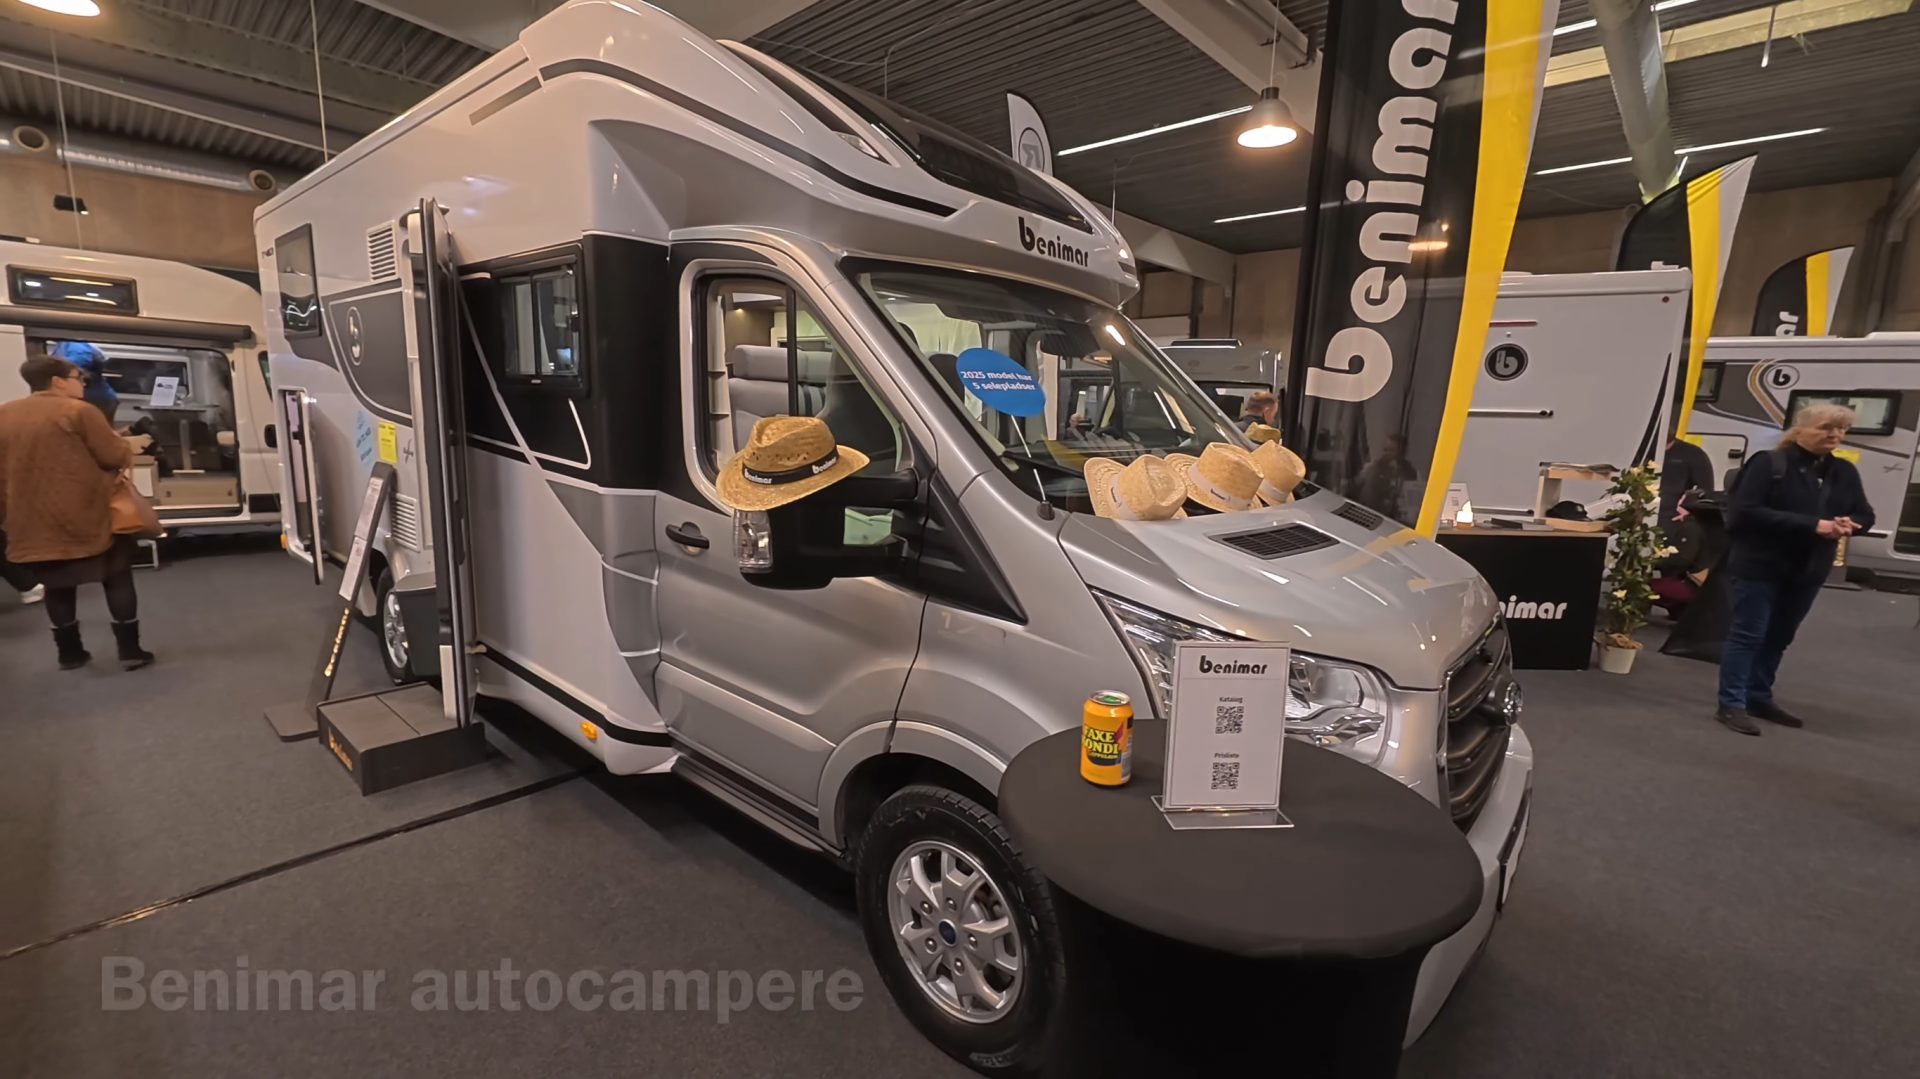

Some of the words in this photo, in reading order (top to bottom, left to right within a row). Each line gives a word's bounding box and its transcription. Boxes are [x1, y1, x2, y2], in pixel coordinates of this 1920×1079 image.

[1305, 0, 1460, 402] benimar
[1018, 216, 1089, 268] benimar
[960, 371, 986, 379] 2025
[987, 372, 1017, 380] model
[1017, 373, 1033, 381] har
[972, 382, 980, 390] 5
[981, 382, 1036, 391] selepladser
[1498, 594, 1568, 620] imar
[1199, 655, 1269, 675] benimar
